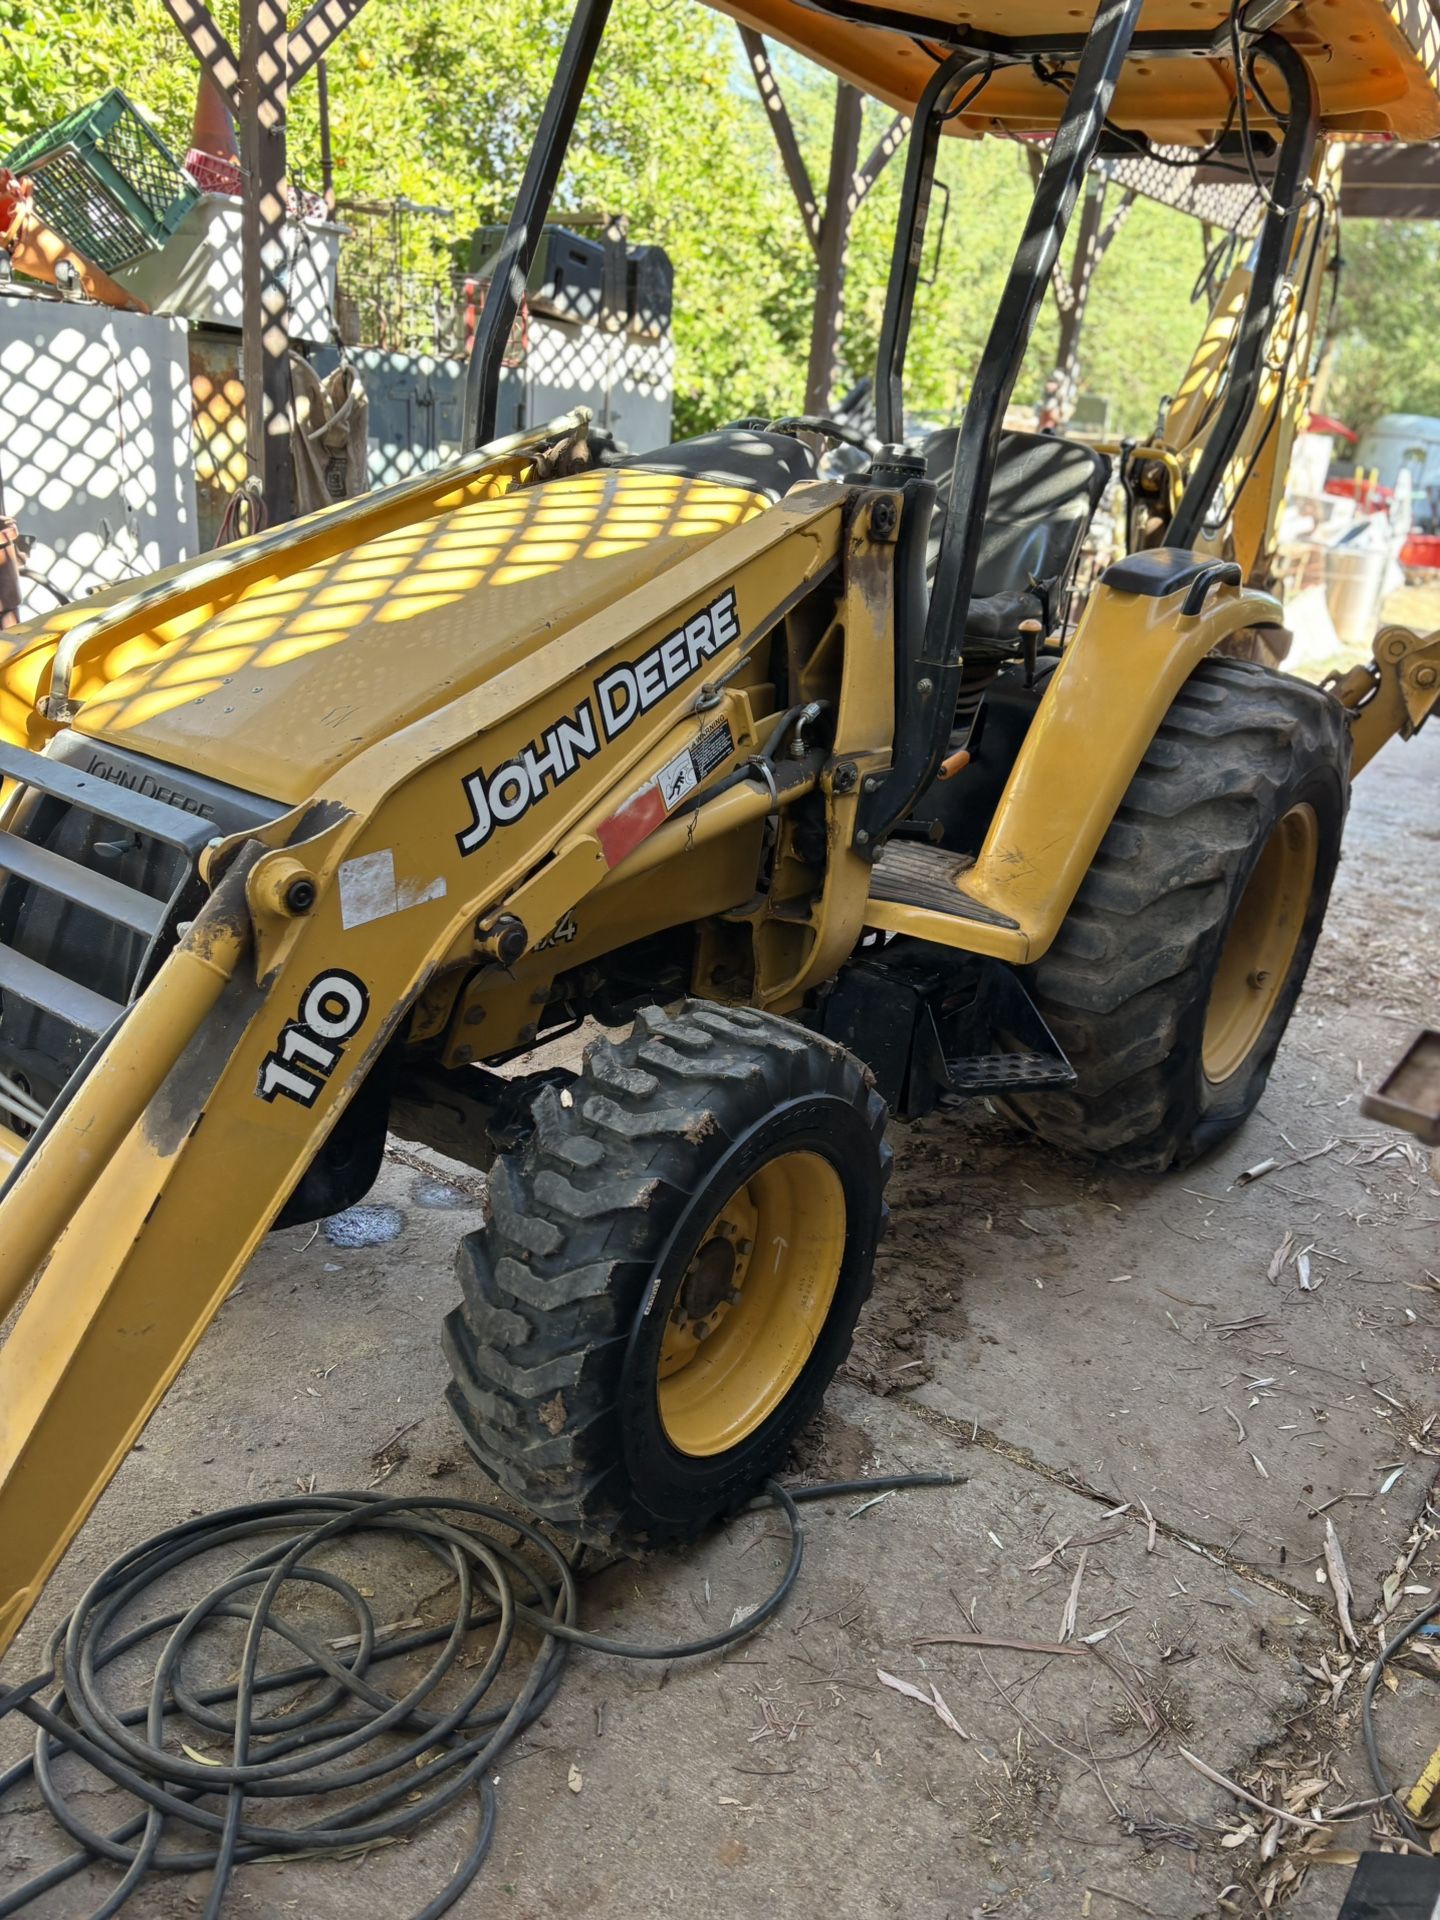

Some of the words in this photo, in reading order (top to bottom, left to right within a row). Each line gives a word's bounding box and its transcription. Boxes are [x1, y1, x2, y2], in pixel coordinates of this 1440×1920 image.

[456, 698, 601, 858] JOHN
[593, 586, 741, 744] DEERE
[697, 714, 725, 742] WARNING
[86, 754, 137, 788] JOHN
[254, 968, 370, 1109] 110
